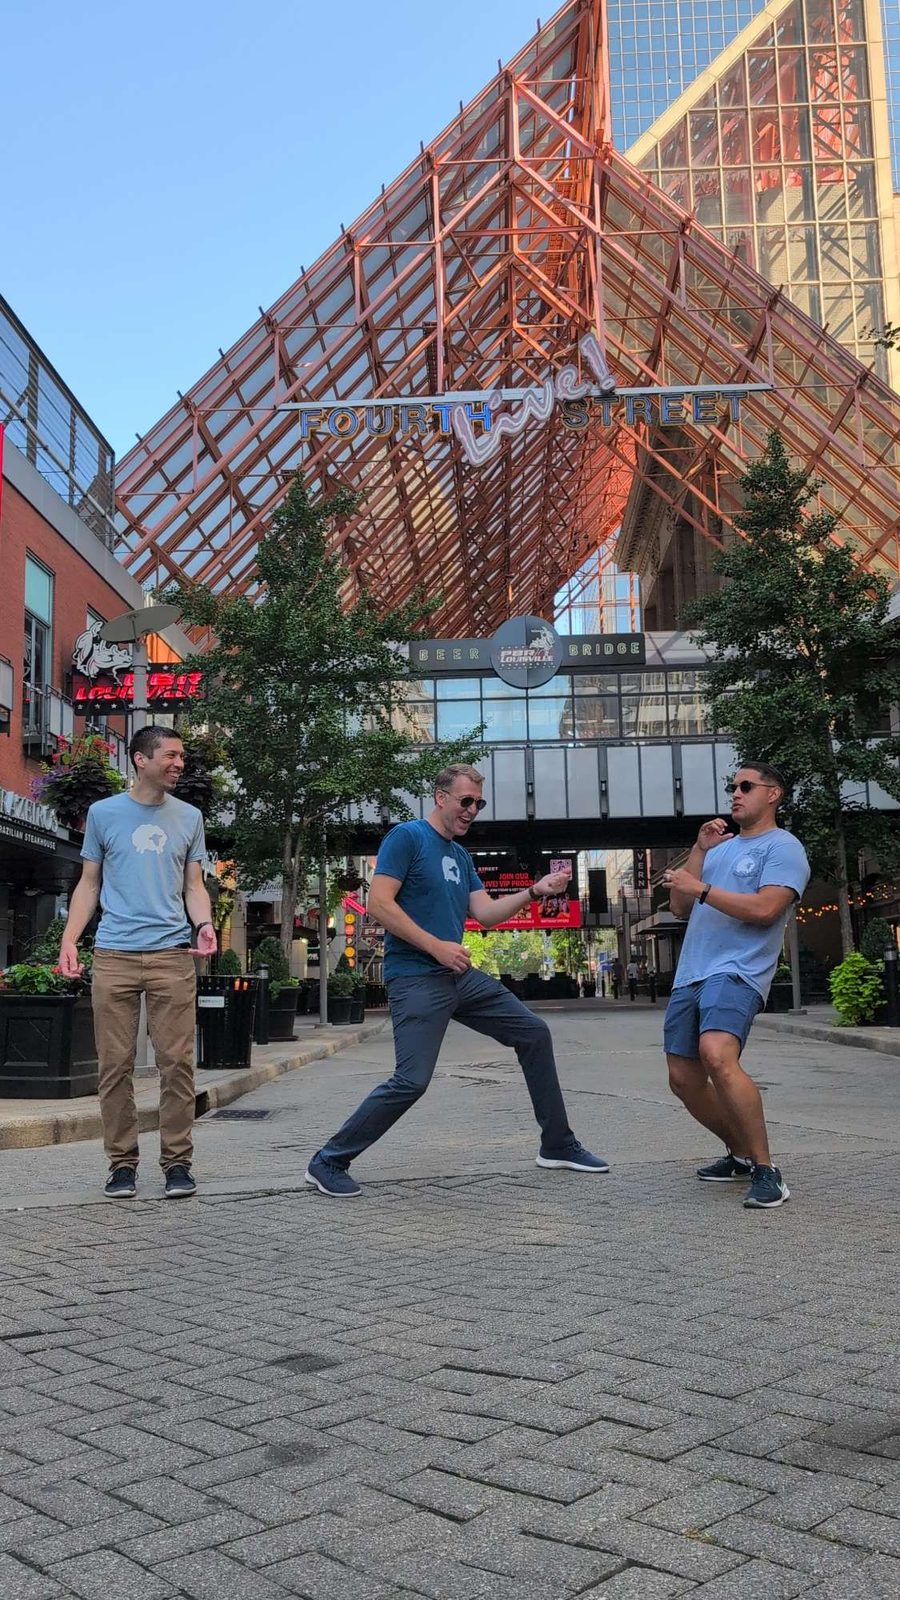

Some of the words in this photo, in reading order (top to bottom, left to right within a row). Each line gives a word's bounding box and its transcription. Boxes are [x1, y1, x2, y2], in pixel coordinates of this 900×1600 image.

[452, 332, 616, 467] Live!
[299, 402, 494, 440] FOURTH
[561, 391, 747, 431] STREET
[418, 647, 480, 662] BEER
[568, 642, 640, 656] BRIDGE
[500, 649, 535, 657] PBR
[500, 655, 555, 663] LOUISVILLE
[24, 833, 56, 850] STEAKHOUSE
[515, 872, 529, 880] OUR
[511, 879, 537, 887] PROGR
